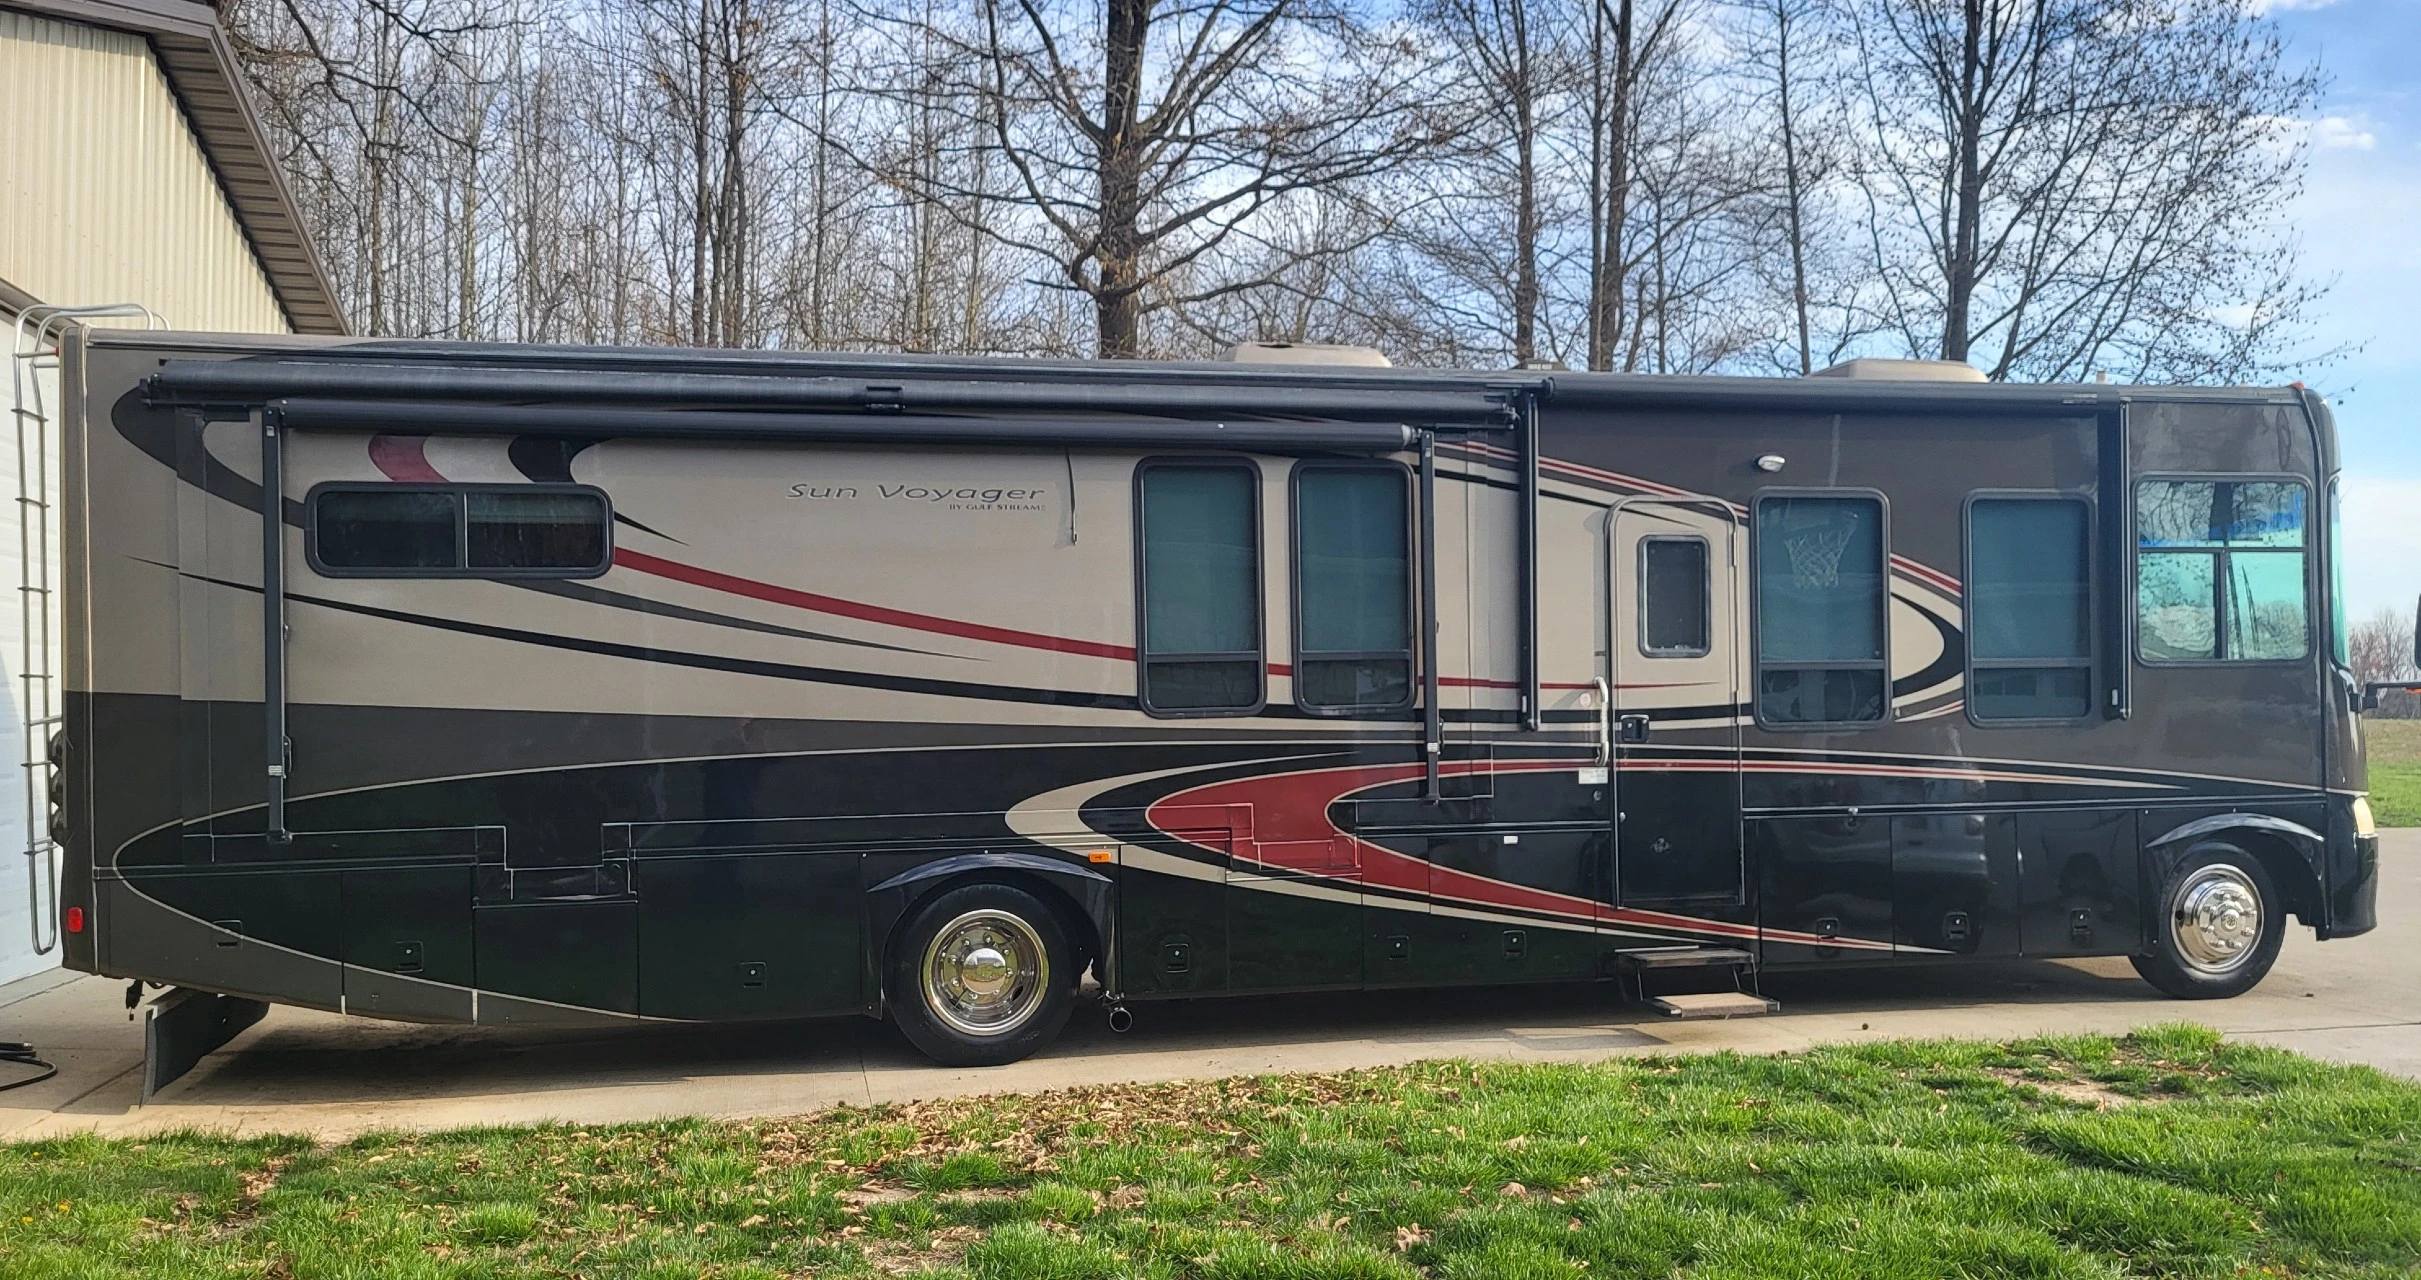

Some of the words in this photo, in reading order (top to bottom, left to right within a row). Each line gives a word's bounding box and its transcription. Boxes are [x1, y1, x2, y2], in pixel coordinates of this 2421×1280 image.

[787, 483, 858, 498] Sun
[877, 484, 1045, 503] Voyager
[949, 503, 961, 511] BY
[965, 503, 992, 511] GULF
